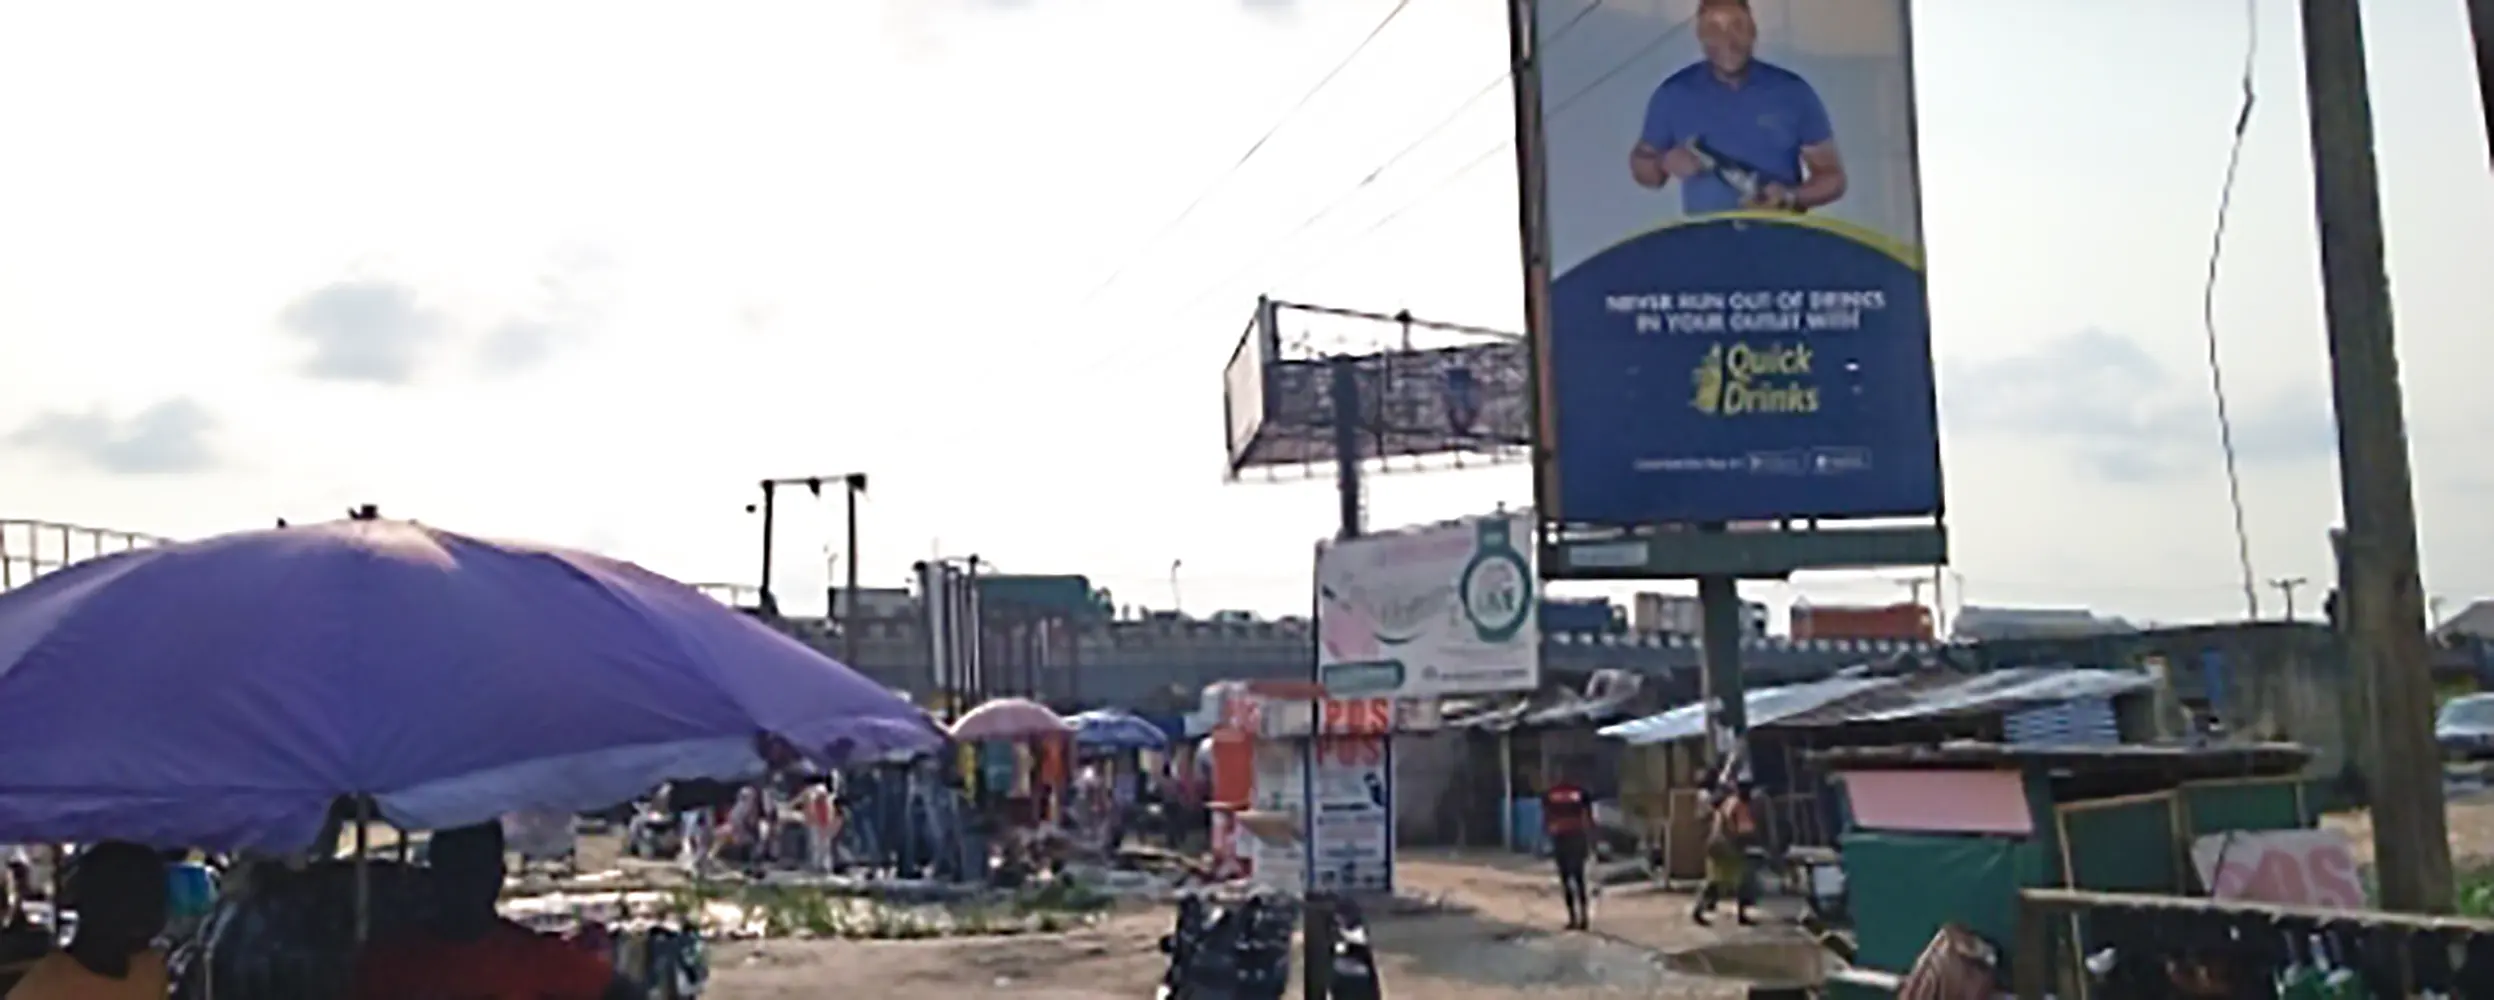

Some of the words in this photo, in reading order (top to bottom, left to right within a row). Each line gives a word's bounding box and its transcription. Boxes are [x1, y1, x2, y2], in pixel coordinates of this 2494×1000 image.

[1605, 293, 1673, 311] NEVER
[1677, 292, 1725, 311] RUN
[1728, 290, 1772, 310] OUT
[1776, 290, 1804, 310] OF
[1808, 289, 1886, 310] DRINKS
[1636, 313, 1661, 334] IN
[1665, 311, 1726, 334] YOUR
[1729, 311, 1800, 333] OUTLET
[1804, 309, 1860, 331] WITH
[1727, 342, 1814, 383] Quick
[1724, 380, 1820, 415] Drinks
[1325, 697, 1390, 735] POS
